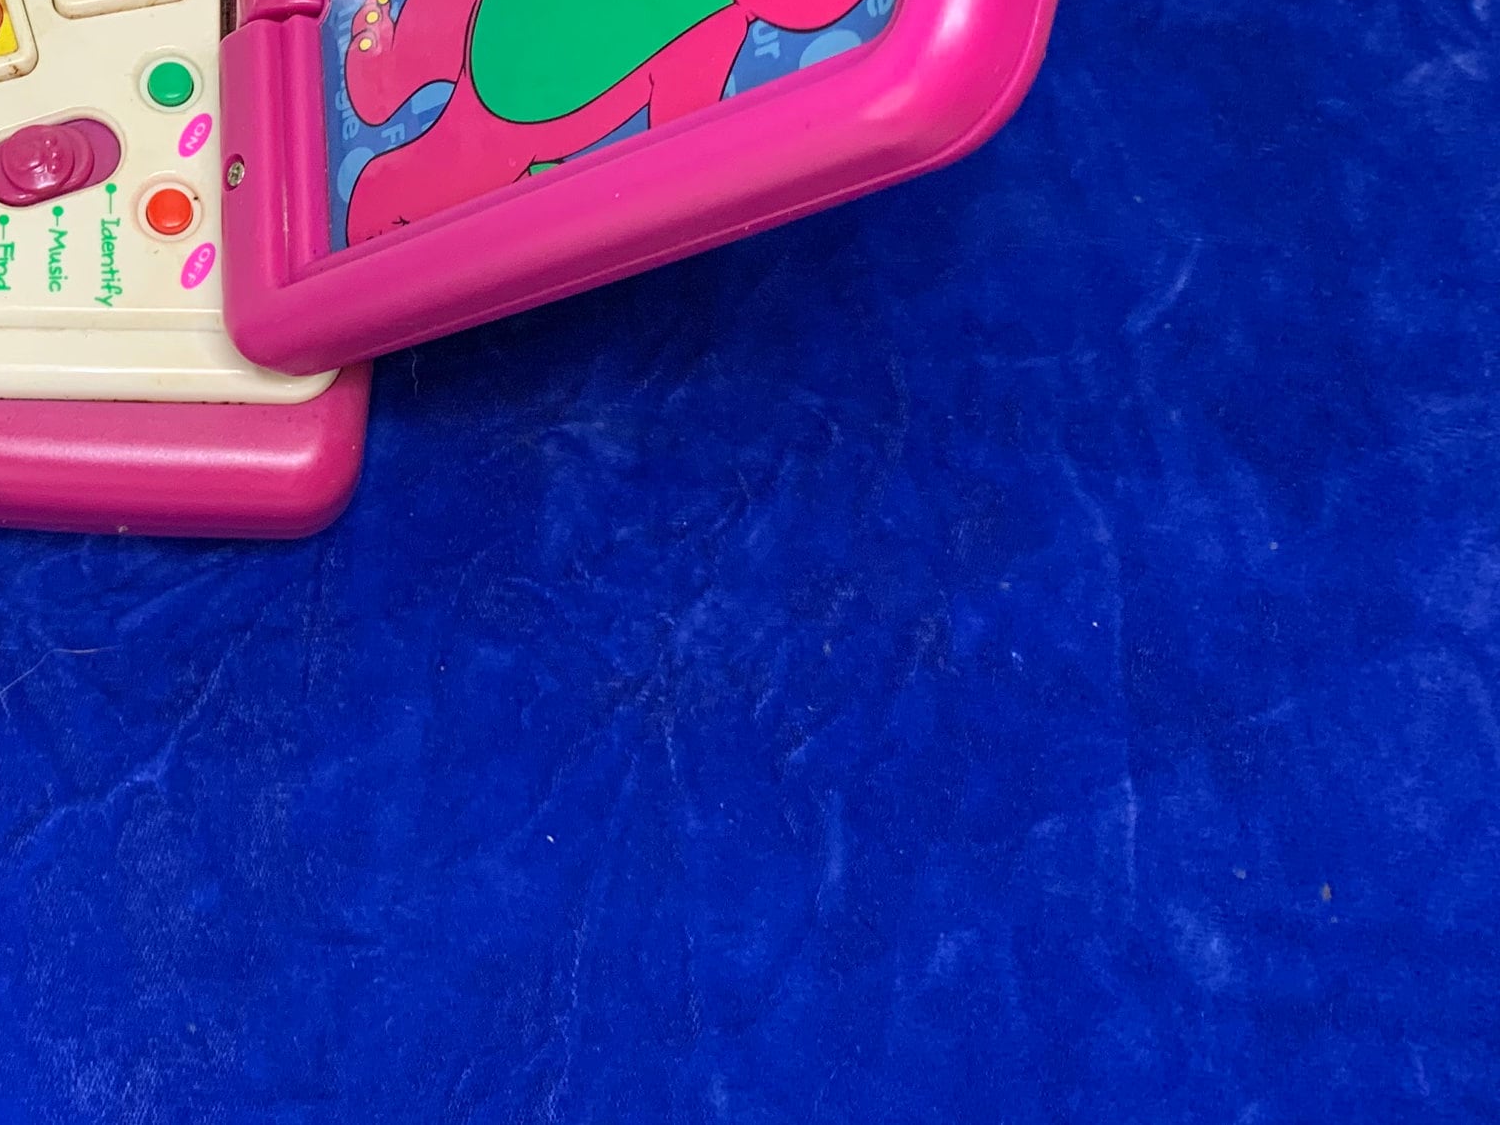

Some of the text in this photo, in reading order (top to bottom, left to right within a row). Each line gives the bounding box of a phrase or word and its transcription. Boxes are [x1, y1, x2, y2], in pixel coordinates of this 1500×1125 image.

[186, 122, 205, 149] ON
[48, 228, 68, 292] Music
[95, 218, 122, 306] Identify
[187, 248, 210, 284] OFF
